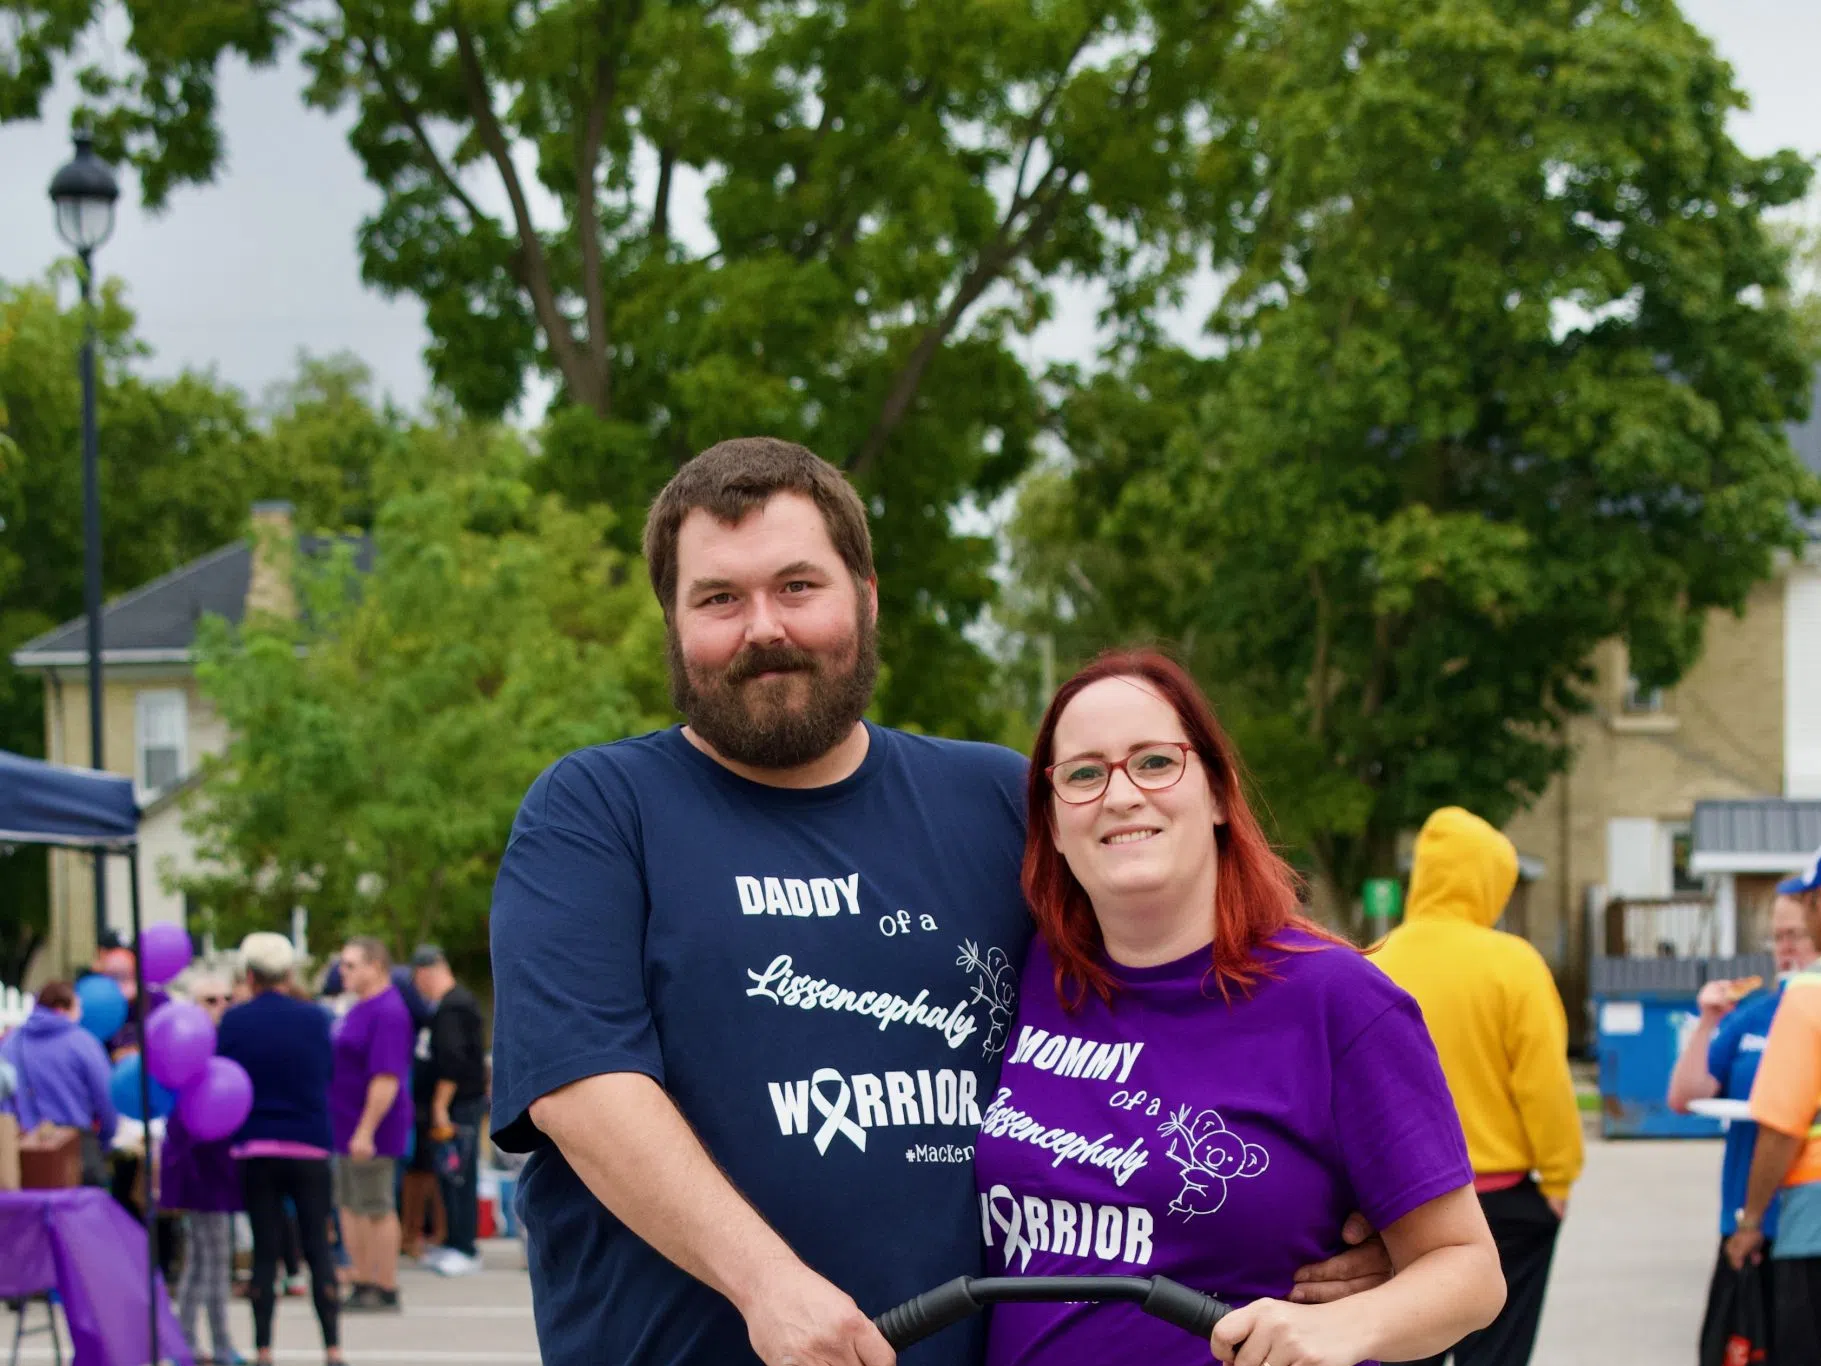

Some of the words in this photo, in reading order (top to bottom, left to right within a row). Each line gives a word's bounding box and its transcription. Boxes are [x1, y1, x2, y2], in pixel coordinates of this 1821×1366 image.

[735, 873, 861, 917] DADDY
[920, 911, 938, 932] a
[746, 954, 977, 1049] Lissencephaly
[1146, 1097, 1161, 1116] a
